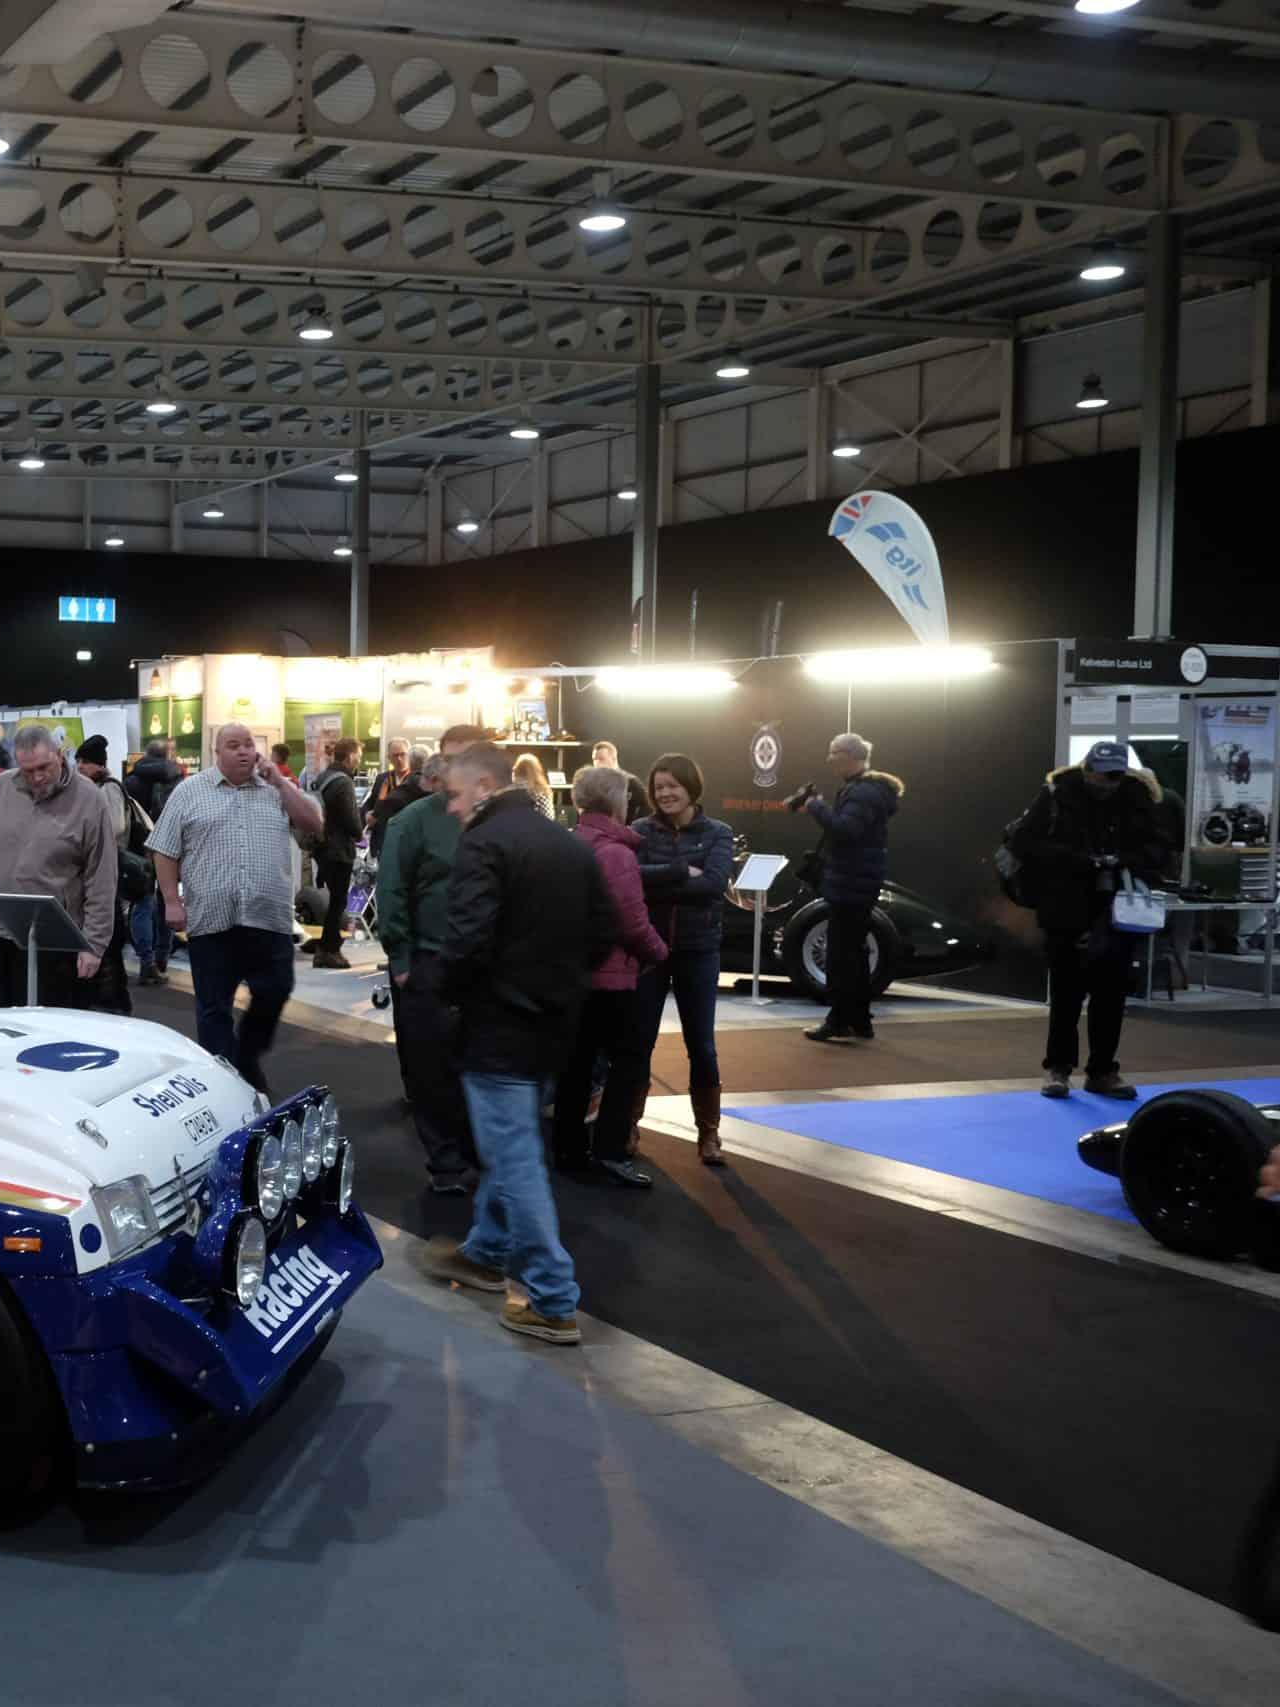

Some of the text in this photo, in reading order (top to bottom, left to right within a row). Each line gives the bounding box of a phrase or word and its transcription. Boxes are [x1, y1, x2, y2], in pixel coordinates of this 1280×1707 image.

[132, 1073, 208, 1117] Shell Oils
[243, 1244, 343, 1339] Racing
